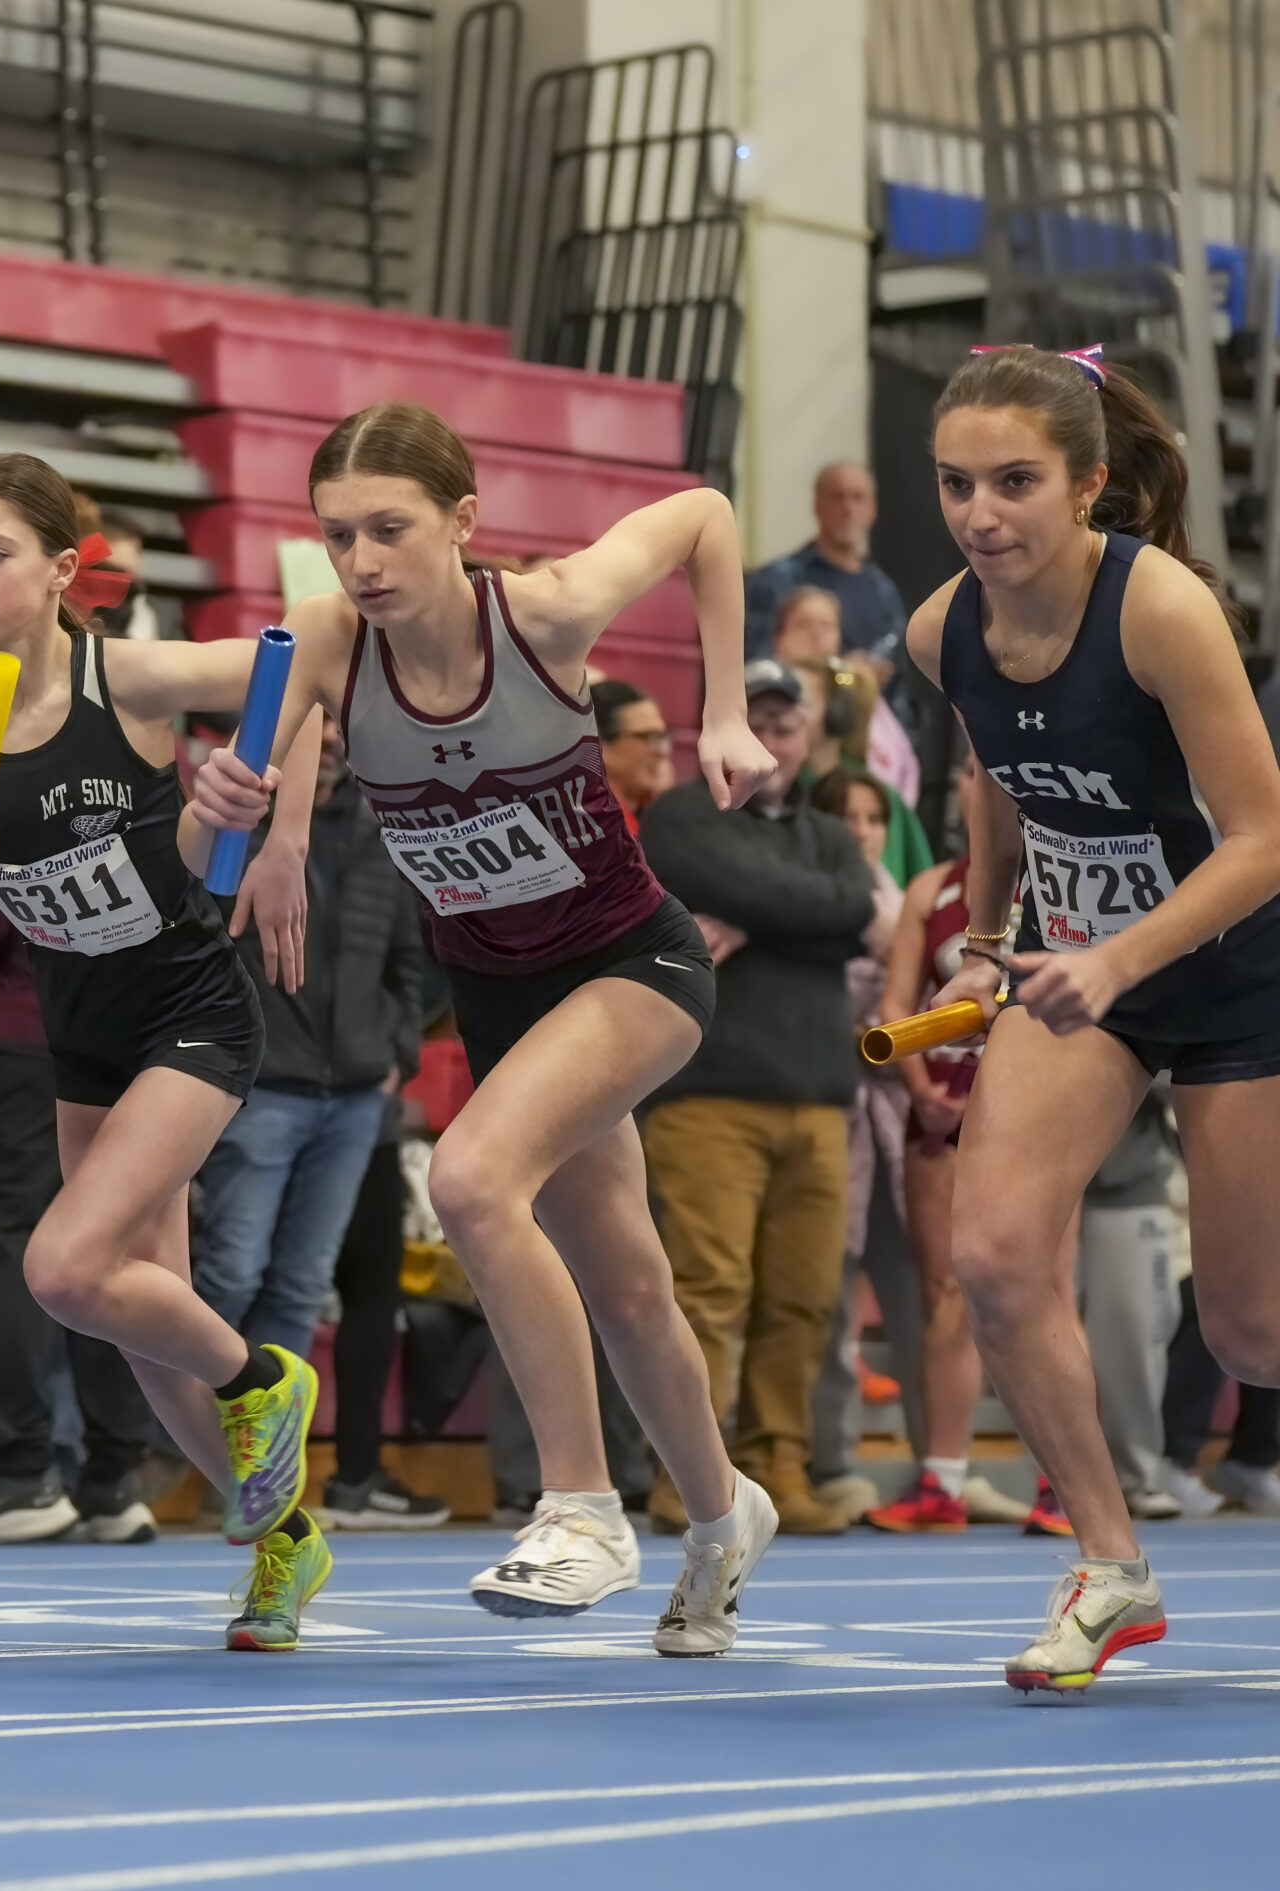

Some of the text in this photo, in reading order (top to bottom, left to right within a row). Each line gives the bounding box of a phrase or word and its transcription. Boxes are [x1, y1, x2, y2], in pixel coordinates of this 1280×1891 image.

[40, 778, 134, 821] MT. SINAI
[986, 762, 1132, 810] ESM
[389, 829, 450, 846] Schwab's
[450, 823, 479, 839] 2nd
[479, 806, 517, 828] Wind
[1028, 825, 1076, 853] Schwab's
[1077, 841, 1106, 856] 2nd
[1108, 838, 1148, 855] Wind
[44, 853, 73, 875] 2nd
[74, 838, 112, 864] Wind
[400, 824, 546, 883] 5604
[434, 886, 458, 903] 2nd
[451, 890, 483, 902] WIND
[1033, 849, 1165, 915] 5728
[1047, 915, 1088, 943] 2nd WIND
